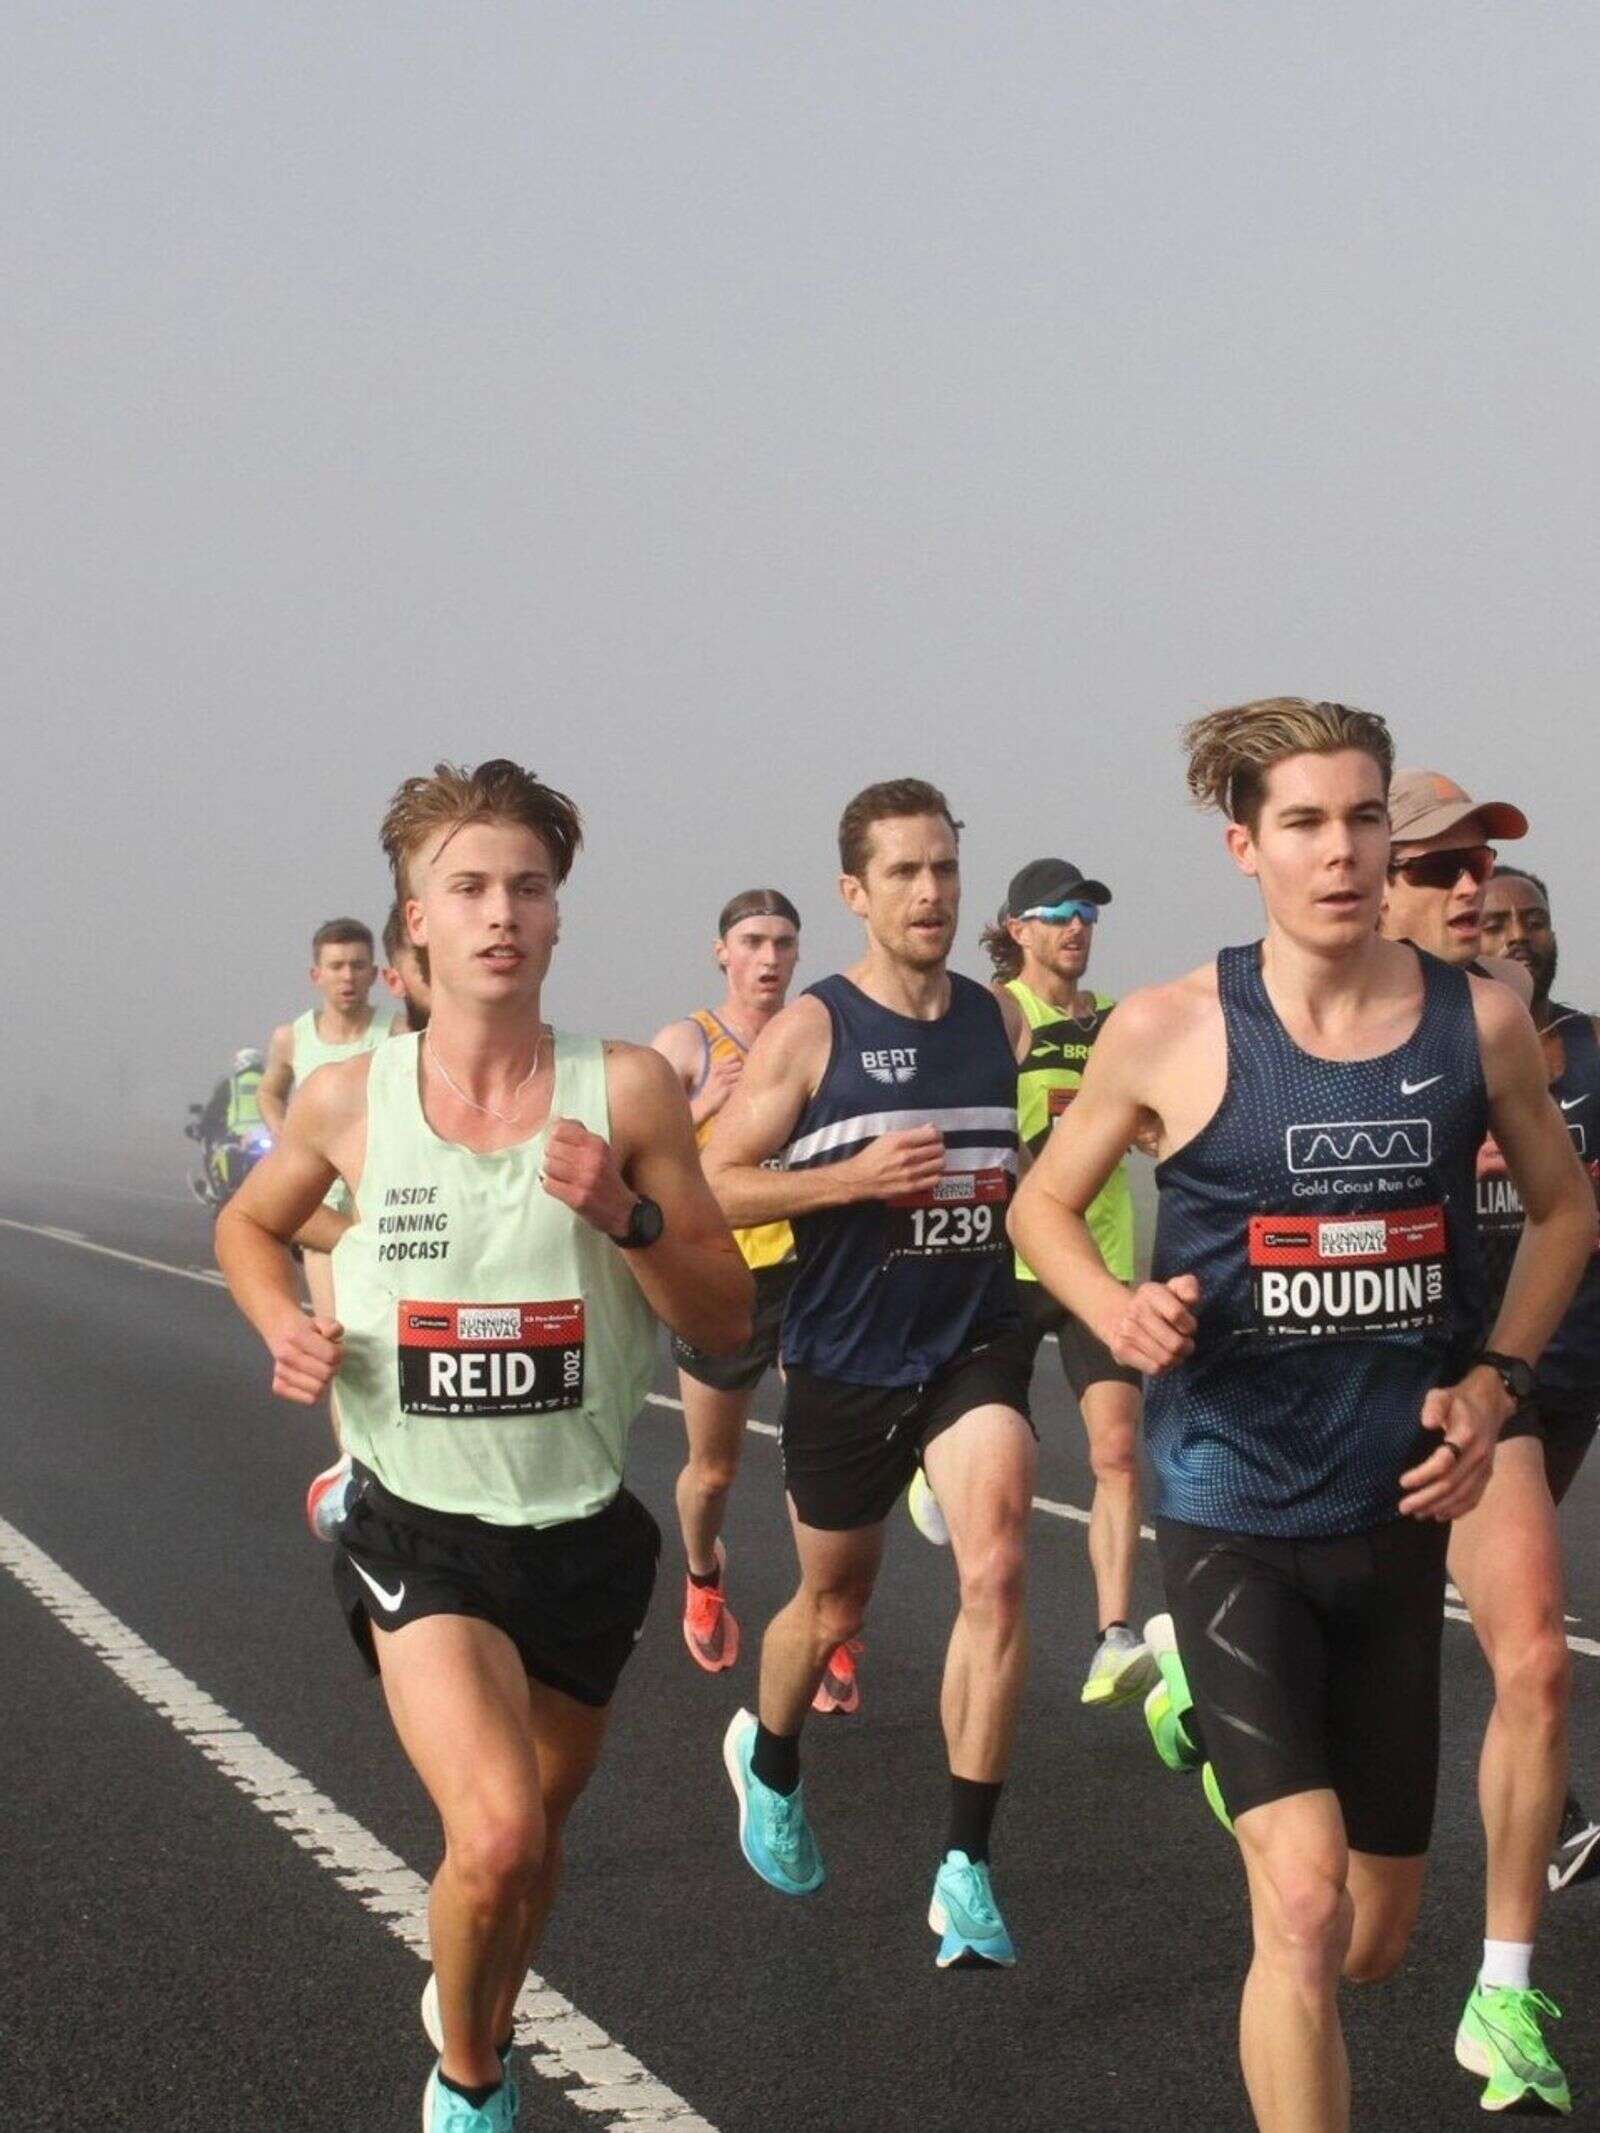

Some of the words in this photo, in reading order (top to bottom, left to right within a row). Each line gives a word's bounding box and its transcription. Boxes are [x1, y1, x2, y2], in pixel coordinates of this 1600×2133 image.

[860, 1048, 917, 1068] BERT
[384, 1187, 438, 1207] INSIDE
[1292, 1180, 1328, 1197] Gold
[1332, 1177, 1374, 1194] Coast
[1378, 1177, 1403, 1192] Run
[1406, 1174, 1426, 1190] Co.
[1476, 1180, 1524, 1214] LIAM
[378, 1213, 448, 1234] RUNNING
[911, 1204, 993, 1246] 1239
[1321, 1229, 1385, 1243] RUNNING
[1321, 1240, 1386, 1254] FESTIVAL
[378, 1240, 450, 1263] PODCAST
[1261, 1264, 1423, 1319] BOUDIN
[1427, 1263, 1442, 1302] 1031
[460, 1316, 519, 1328] RUNNING
[428, 1352, 537, 1398] REID
[563, 1350, 581, 1388] 1002
